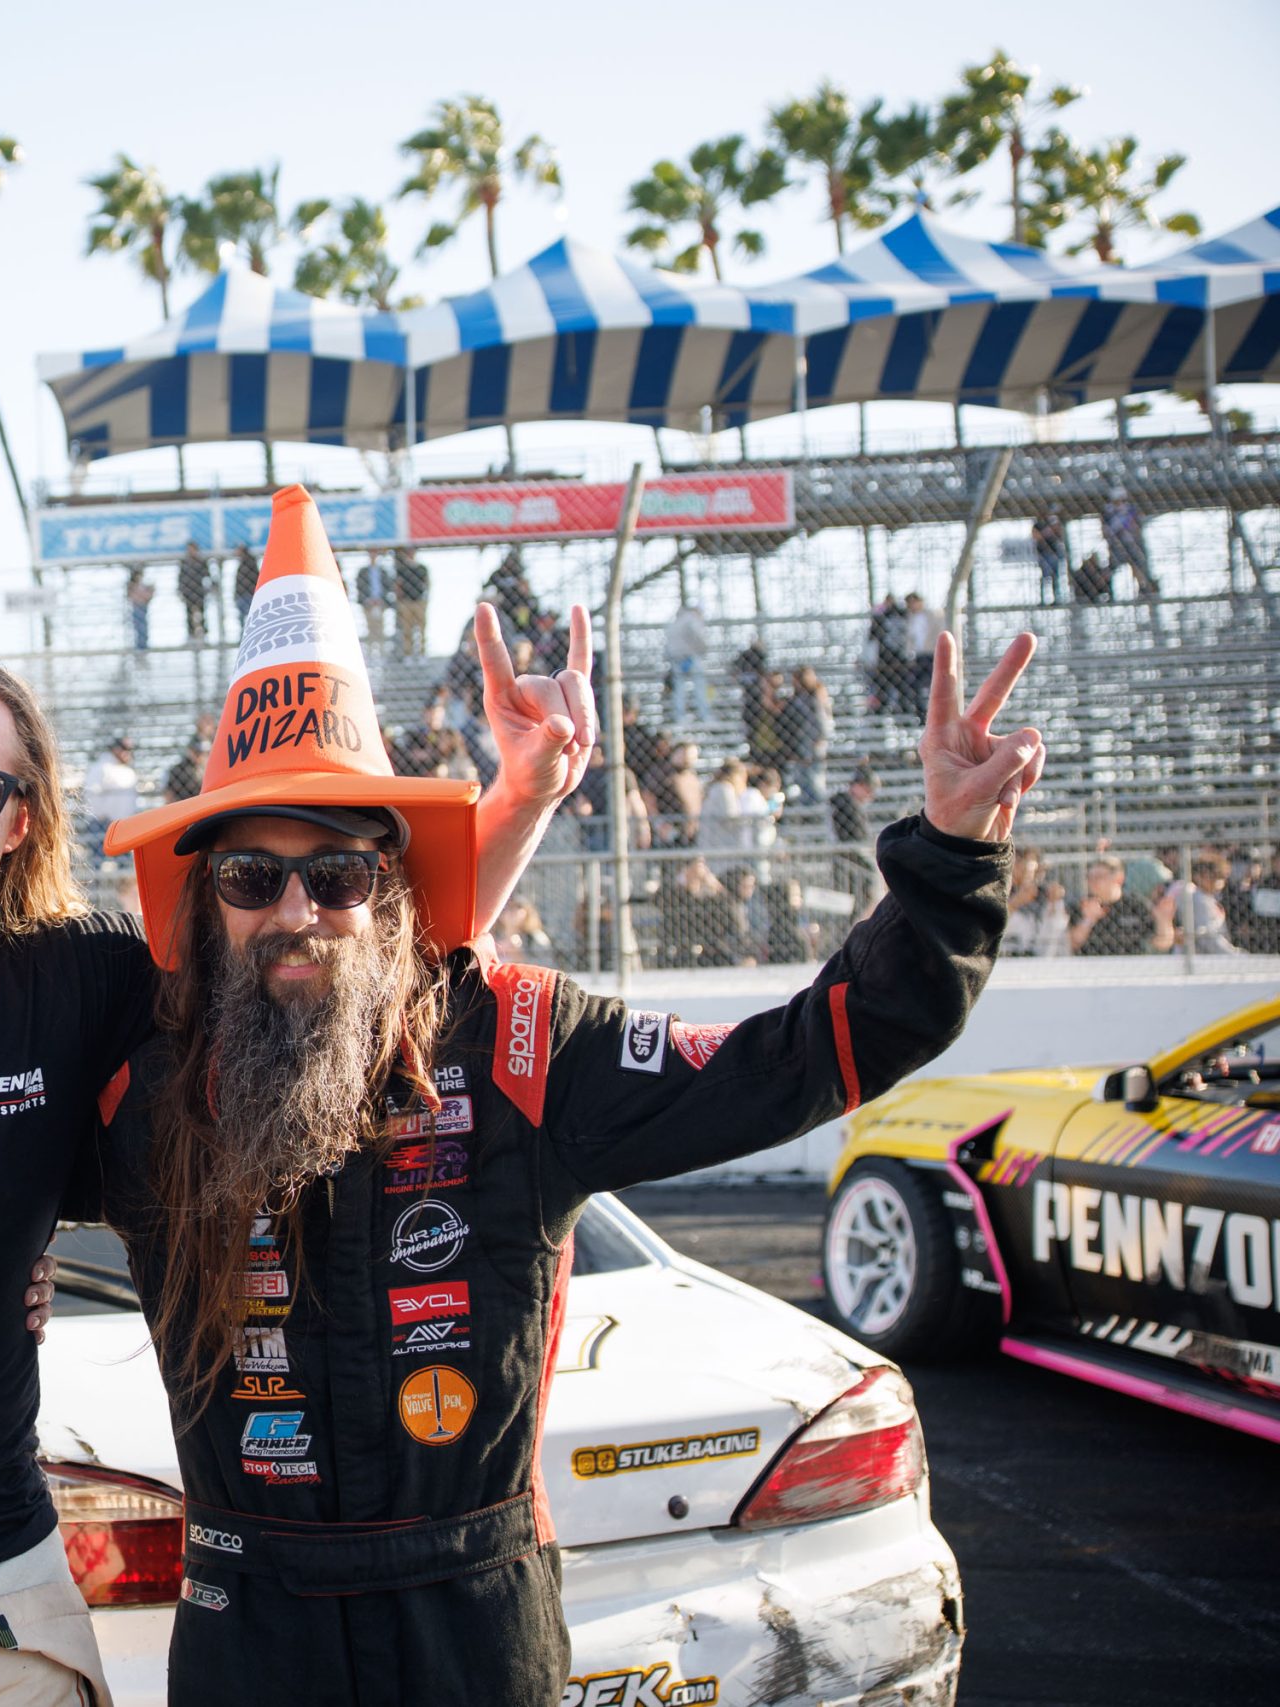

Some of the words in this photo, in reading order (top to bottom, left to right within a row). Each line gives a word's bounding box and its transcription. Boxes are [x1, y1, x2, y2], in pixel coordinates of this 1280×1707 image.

[236, 673, 350, 725] DRIFT
[227, 708, 362, 768] WIZARD
[508, 978, 541, 1077] sparco
[633, 1033, 652, 1057] sfi
[384, 1184, 414, 1194] ENGINE
[390, 1224, 470, 1263] Innovations
[1033, 1180, 1280, 1314] PENNZO
[393, 1294, 467, 1312] EVOL
[392, 1341, 470, 1355] AUTOWORKS
[232, 1376, 302, 1397] SLR
[404, 1399, 433, 1416] VALVE
[444, 1394, 461, 1409] PEN
[619, 1432, 757, 1468] STUKE.RACING
[189, 1523, 243, 1554] sparco
